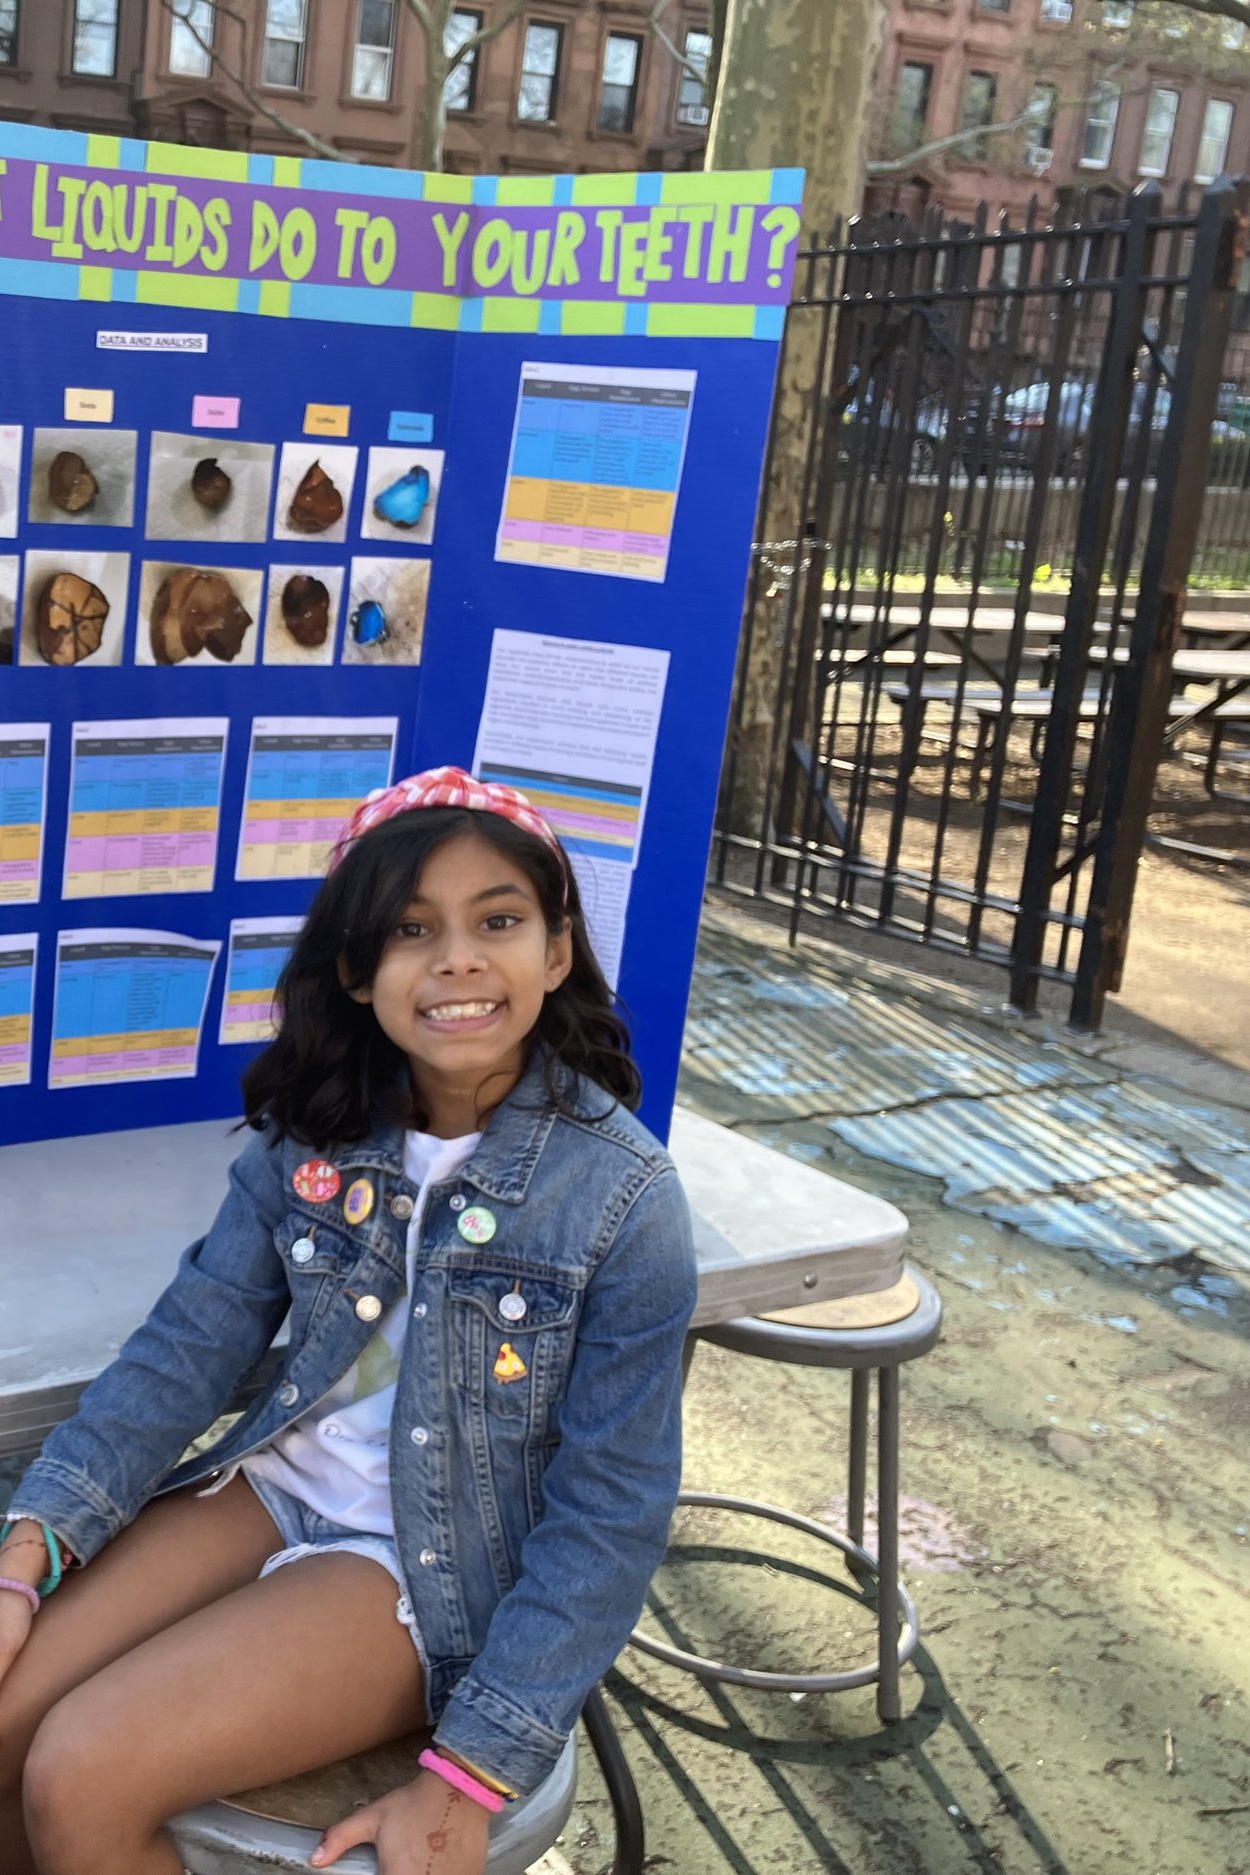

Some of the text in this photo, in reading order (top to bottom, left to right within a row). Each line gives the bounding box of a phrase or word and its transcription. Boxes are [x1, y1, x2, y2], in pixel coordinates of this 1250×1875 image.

[32, 164, 232, 271] LIQUIDS
[249, 200, 317, 280] DO
[335, 208, 396, 285] TO
[432, 211, 586, 295] YOUR
[99, 335, 204, 349] DATA AND ANALYSIS
